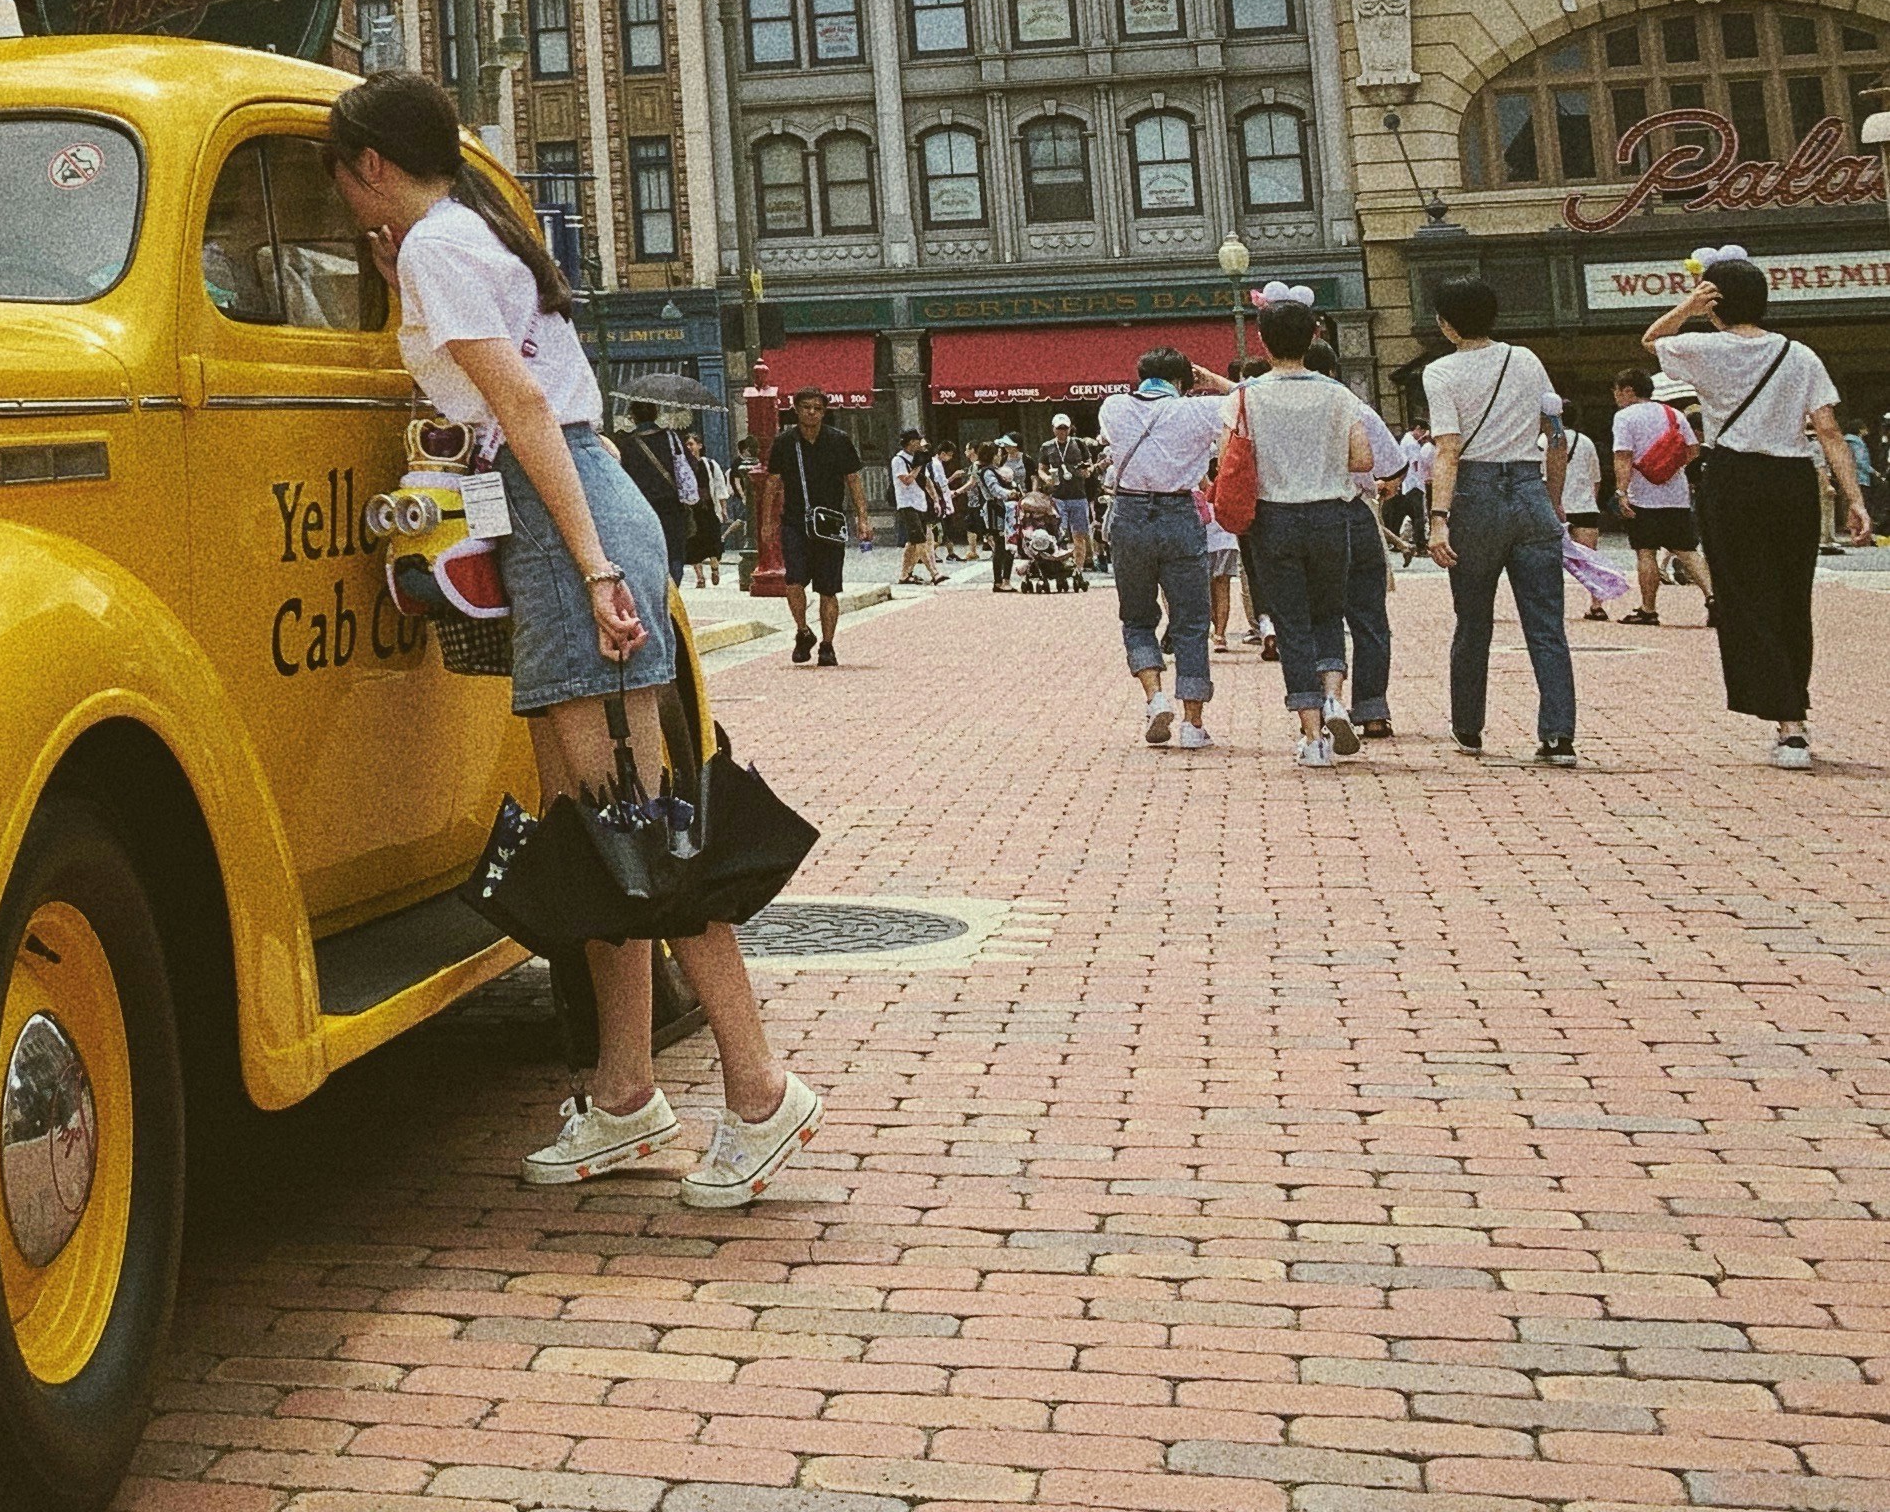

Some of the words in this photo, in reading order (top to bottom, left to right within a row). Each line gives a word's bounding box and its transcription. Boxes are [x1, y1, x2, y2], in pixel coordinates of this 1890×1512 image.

[1611, 272, 1703, 296] WOR
[1069, 384, 1131, 396] GERTNER'S
[272, 579, 358, 677] Cab
